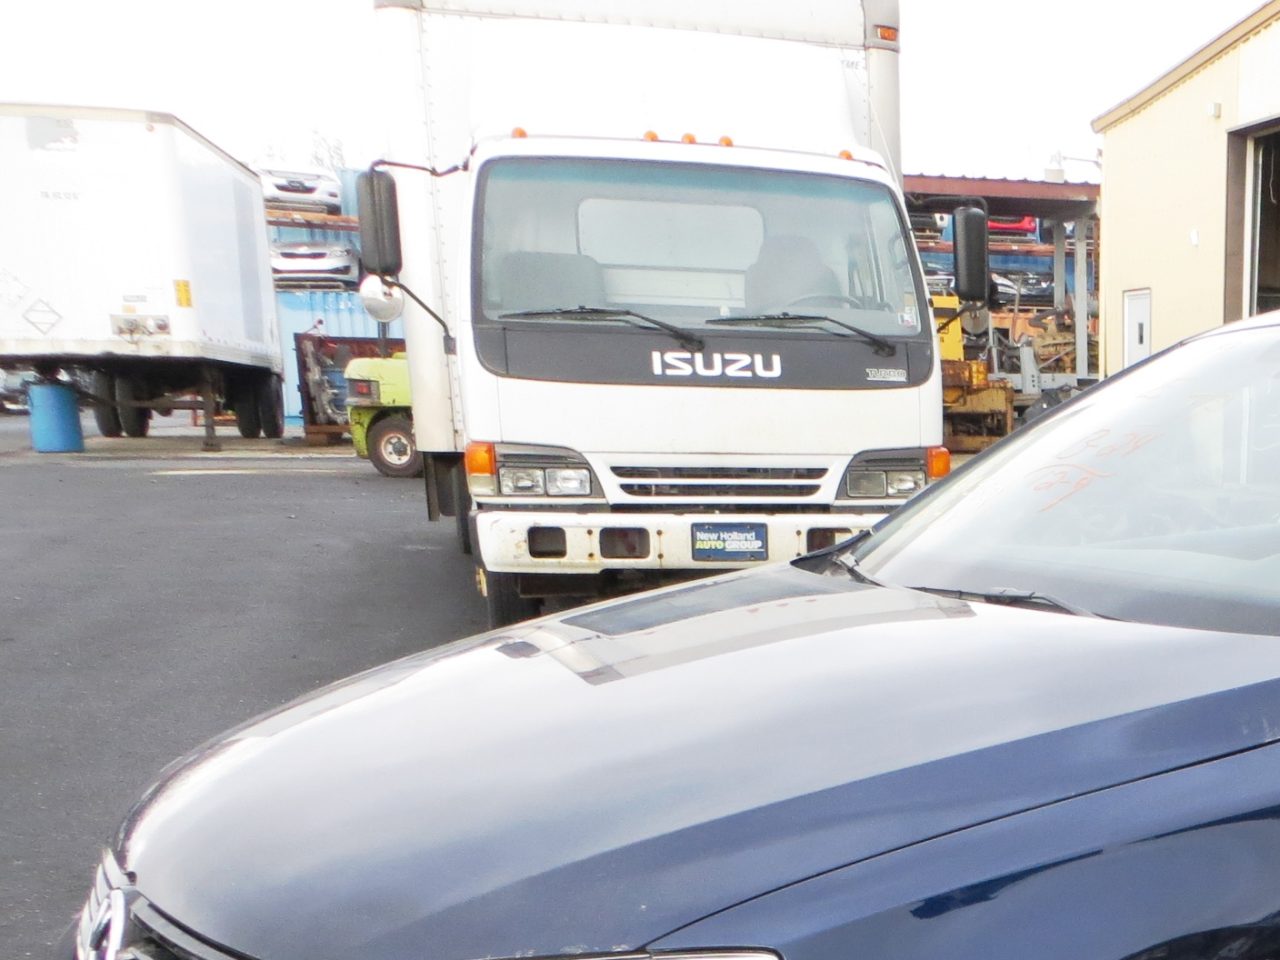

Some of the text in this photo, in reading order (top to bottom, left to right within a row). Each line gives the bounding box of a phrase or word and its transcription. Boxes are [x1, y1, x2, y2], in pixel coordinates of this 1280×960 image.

[651, 350, 781, 378] ISUZU
[696, 531, 756, 541] New Holland
[695, 540, 763, 549] AUTO GROUP
